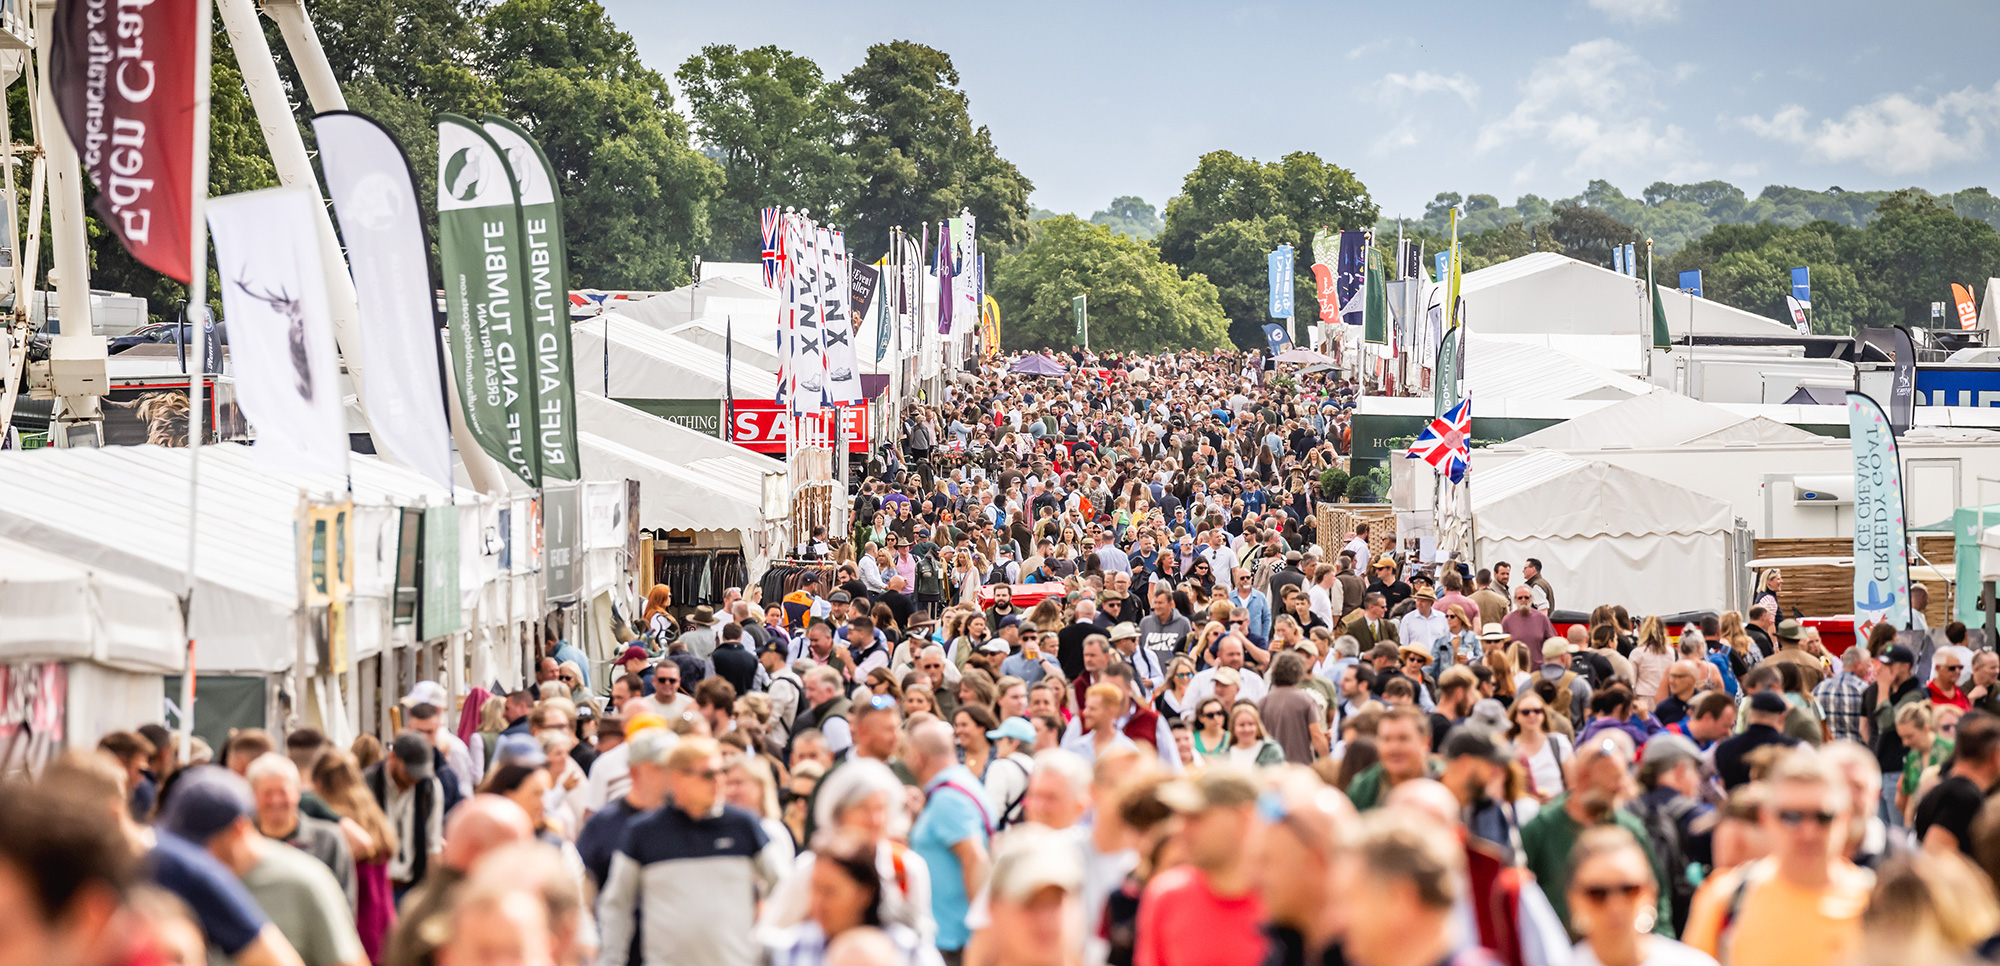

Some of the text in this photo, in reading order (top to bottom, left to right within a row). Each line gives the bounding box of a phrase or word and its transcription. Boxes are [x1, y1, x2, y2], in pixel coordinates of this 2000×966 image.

[796, 249, 819, 355] LANX
[821, 249, 849, 348] LANX
[852, 281, 870, 299] allery
[1144, 632, 1179, 651] NIKE
